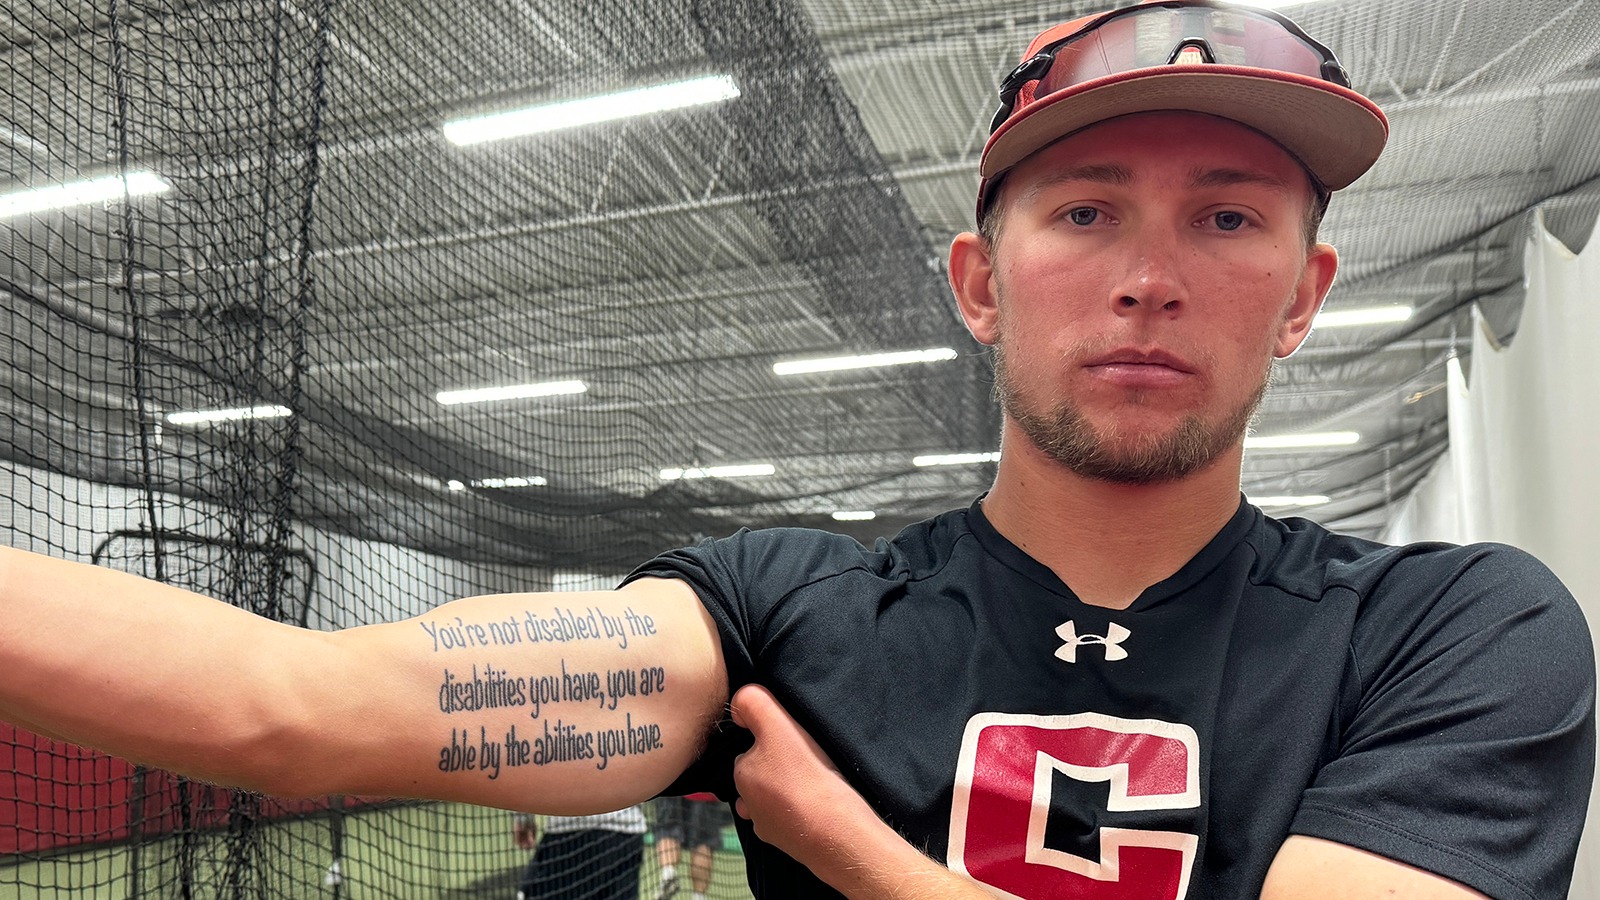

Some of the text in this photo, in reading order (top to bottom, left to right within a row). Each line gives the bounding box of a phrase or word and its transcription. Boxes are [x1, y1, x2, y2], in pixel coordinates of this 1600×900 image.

[420, 606, 657, 652] You're not disabled by the
[439, 658, 665, 719] disabilities you have, you are
[438, 712, 664, 780] able by the abilities you have.
[947, 712, 1201, 900] C
